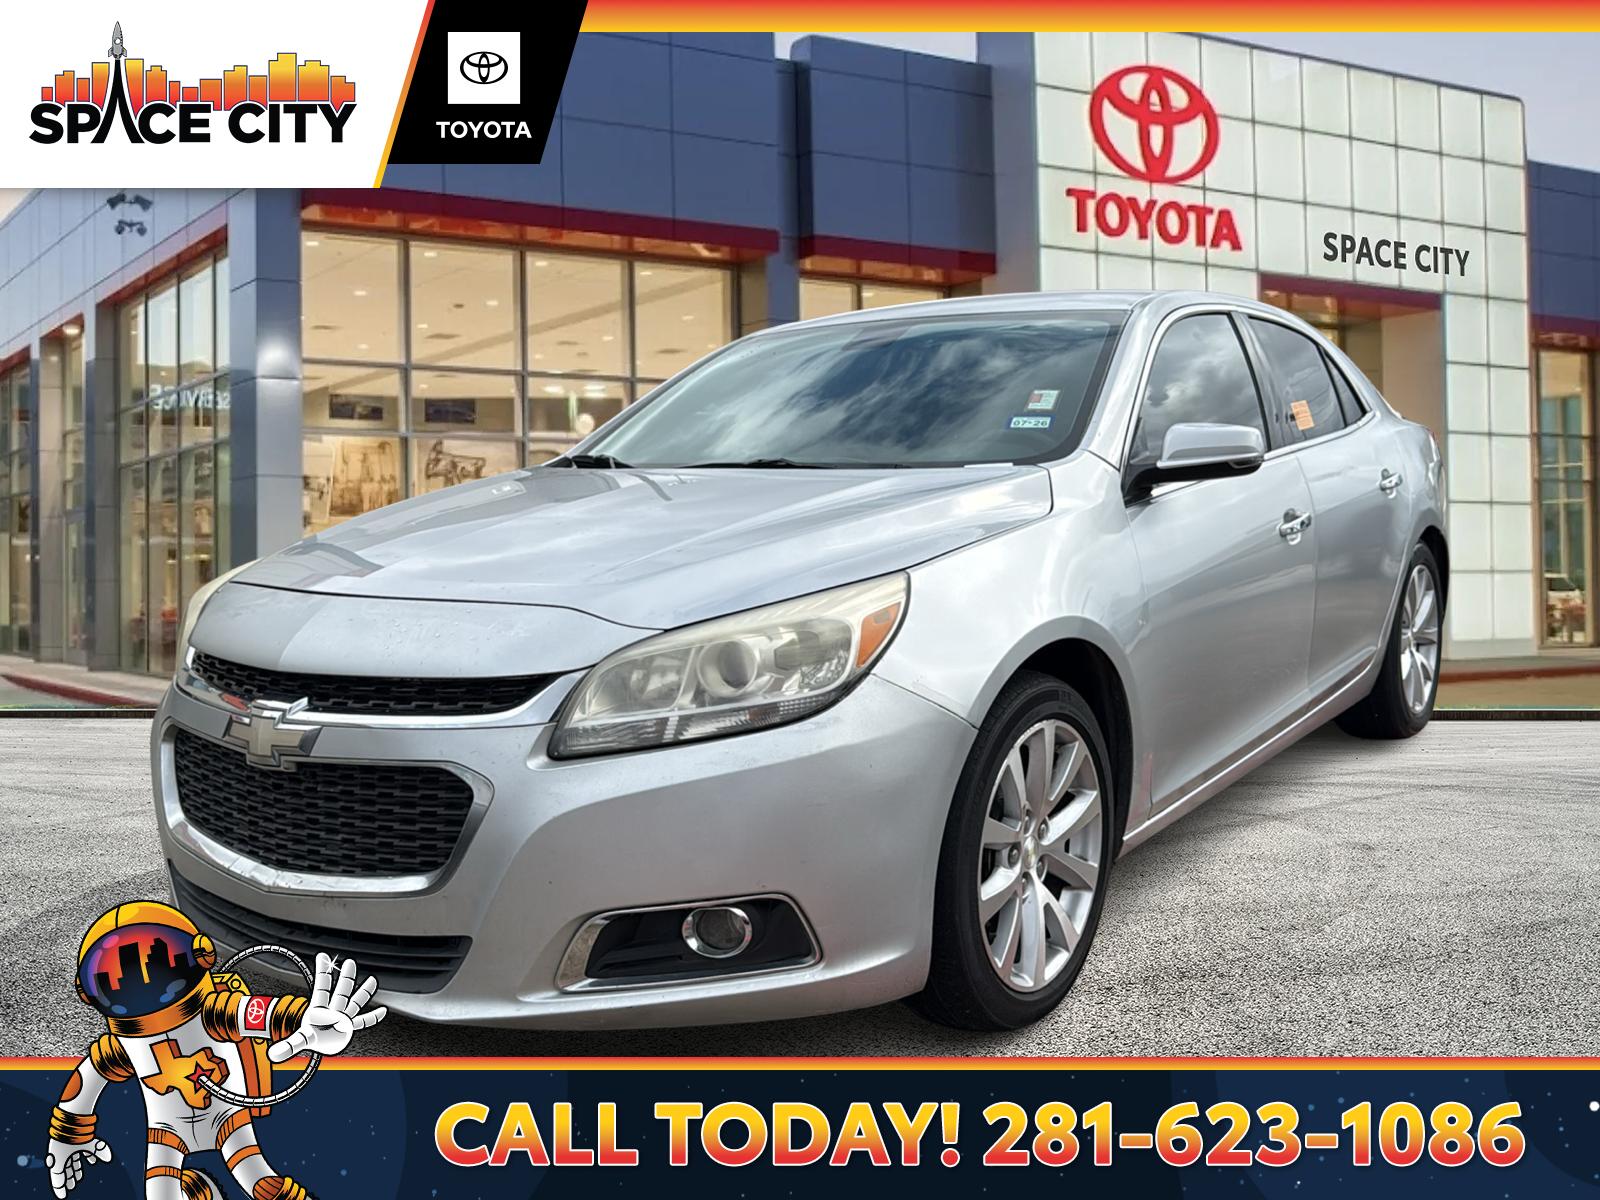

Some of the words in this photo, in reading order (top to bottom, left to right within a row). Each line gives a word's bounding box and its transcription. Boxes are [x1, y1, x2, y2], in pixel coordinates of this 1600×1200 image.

[1066, 187, 1242, 251] TOYOTA
[1323, 231, 1407, 270] SPACE
[1415, 244, 1470, 277] CITY
